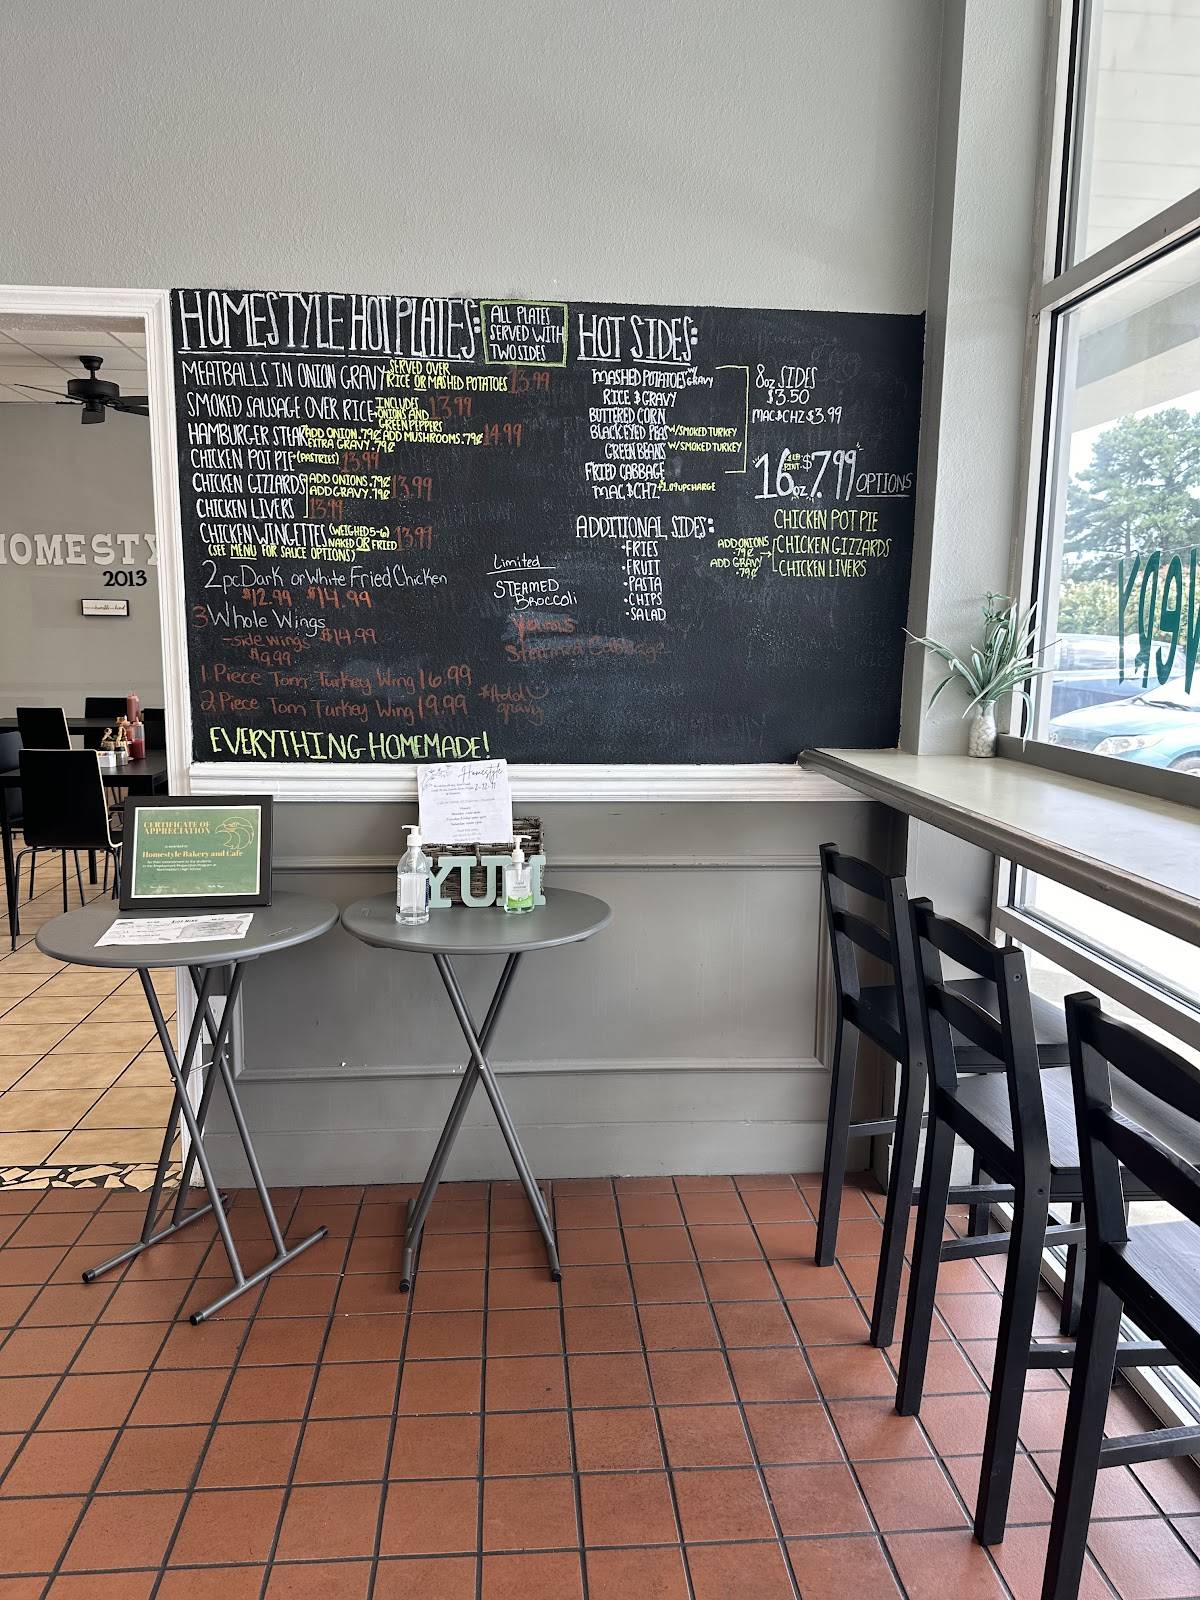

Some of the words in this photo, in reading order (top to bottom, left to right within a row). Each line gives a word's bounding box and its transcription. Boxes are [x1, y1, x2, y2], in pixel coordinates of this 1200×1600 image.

[178, 290, 345, 350] HOMESTYLE
[349, 293, 391, 354] HOT
[394, 297, 480, 360] PLATES:
[490, 306, 512, 324] ALL
[516, 307, 550, 326] PLATES
[490, 325, 529, 342] SERVED
[532, 327, 563, 344] WITH
[577, 313, 625, 358] HOT
[630, 314, 698, 361] SIDES:
[490, 343, 516, 360] TWO
[517, 343, 546, 361] SIDES
[182, 360, 269, 387] MEATBALLS
[271, 362, 293, 387] IN
[298, 363, 336, 388] ONION
[340, 364, 387, 390] GRAVY
[389, 360, 422, 375] SERVED
[426, 361, 450, 375] OVER
[387, 373, 410, 388] RICE
[414, 375, 427, 388] OR
[428, 376, 464, 390] MASHED
[466, 376, 508, 391] POTATOES
[592, 368, 641, 386] MASHED
[642, 369, 687, 389] POTATOES
[778, 366, 818, 389] SIDES
[375, 397, 419, 410] INCLUDES
[603, 389, 631, 405] RICE
[642, 391, 677, 407] GRAVY
[766, 389, 810, 405] $3.50
[187, 392, 242, 417] SMOKED
[246, 396, 301, 418] SAUSAGE
[305, 396, 339, 420] OVER
[342, 399, 374, 422] RICE
[378, 409, 407, 419] ONIONS
[408, 410, 429, 421] AND
[589, 407, 636, 424] BUTTERED
[637, 408, 666, 425] CORN
[805, 406, 842, 424] $3.99
[187, 422, 269, 446] HAMBURGER
[273, 426, 308, 447] STEAK
[379, 420, 408, 431] GREEN
[409, 420, 443, 432] PEPPERS
[649, 425, 669, 440] PEAS
[708, 427, 737, 438] TURKEY
[305, 428, 324, 438] ADD
[326, 427, 357, 439] ONION
[383, 431, 402, 441] ADD
[404, 431, 460, 444] MUSHROOMS
[308, 439, 334, 449] EXTRA
[337, 440, 370, 451] GRAVY
[605, 442, 637, 459] GREEN
[638, 443, 666, 460] BEANS
[711, 442, 742, 453] TURKEY
[190, 448, 243, 470] CHICKEN
[247, 448, 271, 470] POT
[274, 450, 295, 471] PIE
[309, 473, 331, 484] ADD
[332, 473, 367, 486] ONIONS
[585, 462, 617, 481] FRIED
[620, 461, 665, 481] CABBAGE
[192, 472, 243, 493] CHICKEN
[247, 473, 305, 495] GIZZARDS
[856, 472, 913, 493] OPTIONS
[310, 485, 332, 496] ADD
[333, 487, 368, 499] GRAVY
[196, 498, 248, 519] CHICKEN
[250, 498, 294, 519] LIVERS
[576, 515, 667, 540] ADDITIONAL
[671, 515, 715, 539] SIDES:
[774, 509, 827, 530] CHICKEN
[831, 509, 857, 531] POT
[859, 511, 879, 532] PIE
[200, 522, 253, 544] CHICKEN
[252, 523, 327, 548] WINGETTES
[328, 537, 354, 549] NAKED
[356, 537, 370, 549] OR
[371, 540, 397, 551] FRIED
[718, 538, 737, 548] ADD
[738, 536, 769, 547] ONIONS
[230, 544, 257, 557] MENU
[262, 544, 277, 558] FOR
[281, 546, 307, 559] SAUCE
[311, 547, 356, 562] OPTIONS)
[626, 540, 658, 557] FRIES
[776, 535, 830, 554] CHICKEN
[832, 536, 892, 558] GIZZARDS
[494, 553, 540, 569] Limited
[627, 559, 660, 575] FRUIT
[710, 558, 731, 568] ADD
[733, 556, 762, 568] GRAVY
[779, 560, 826, 577] CHICKEN
[829, 560, 867, 577] LIVERS
[103, 569, 147, 587] 2013
[305, 567, 347, 587] White
[350, 565, 392, 588] Fried
[392, 563, 448, 588] Chicken
[629, 576, 662, 592] PASTA
[629, 593, 662, 606] CHIPS
[193, 605, 208, 628] 3
[207, 601, 267, 629] Whole
[272, 608, 326, 637] Wings
[631, 607, 666, 621] SALAD
[214, 663, 262, 685] Piece
[314, 670, 372, 696] Turkey
[376, 667, 416, 694] Wing
[201, 690, 216, 711] 2
[219, 691, 258, 712] Piece
[266, 697, 306, 716] Tom
[310, 697, 368, 722] Turkey
[376, 699, 415, 726] Wing
[210, 727, 366, 760] EVERYTHING
[368, 731, 490, 760] HOMEMADE!
[458, 762, 503, 785] Homestyle
[143, 820, 199, 829] CERTIFICATE
[145, 827, 210, 835] APPRECIATION
[142, 850, 182, 859] Homestyle
[183, 848, 209, 858] Bakery
[211, 848, 225, 857] and
